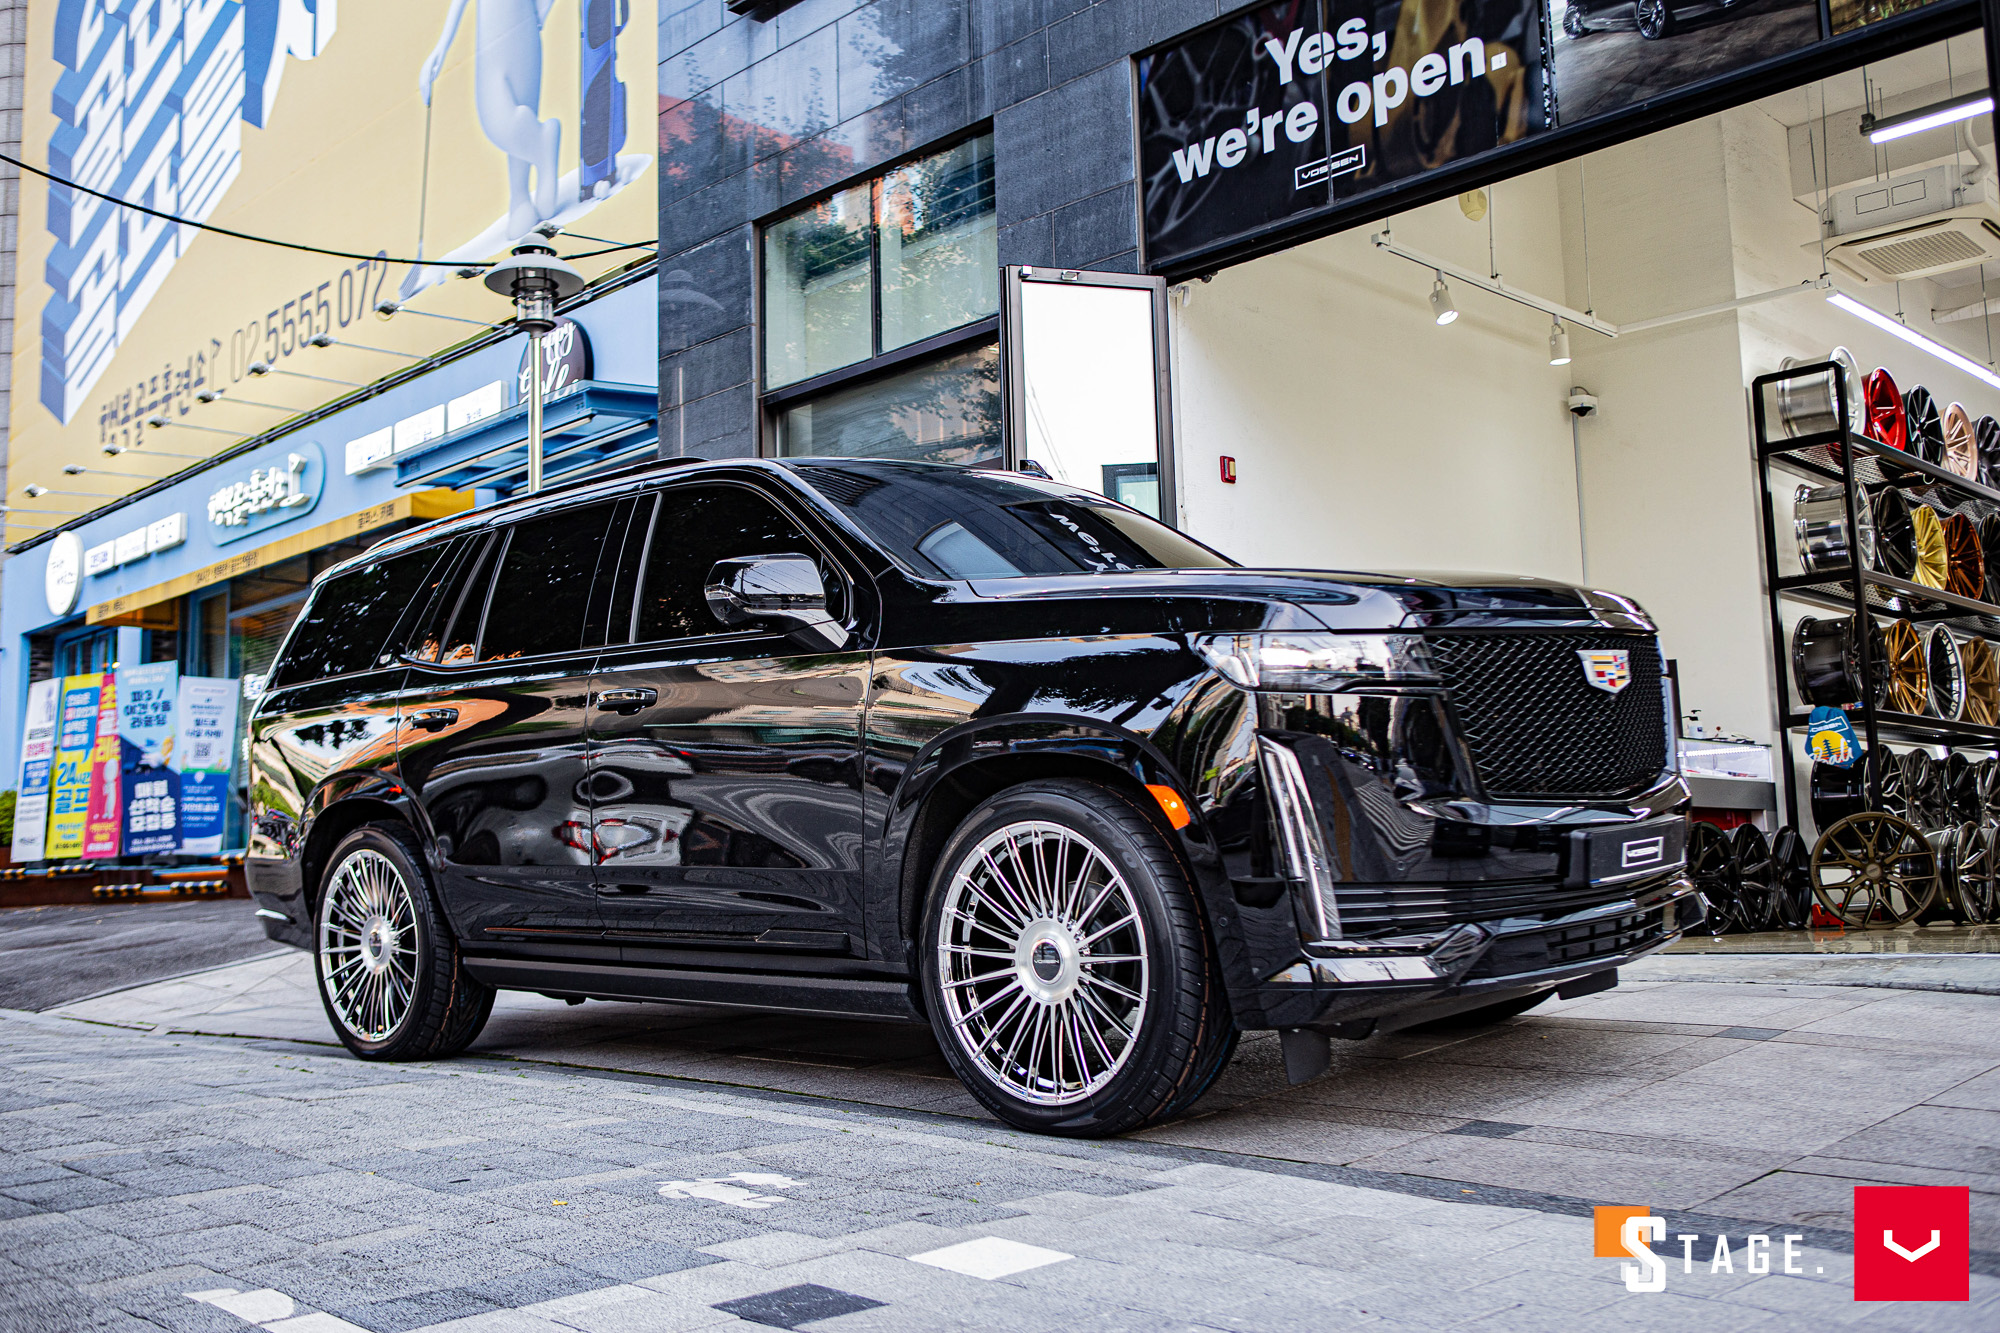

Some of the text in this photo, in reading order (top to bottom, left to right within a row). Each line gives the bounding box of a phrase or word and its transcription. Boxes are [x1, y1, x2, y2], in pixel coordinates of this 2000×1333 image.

[1264, 17, 1386, 86] Yes,
[1173, 36, 1507, 184] we're open.
[1301, 153, 1359, 180] VOSSEN
